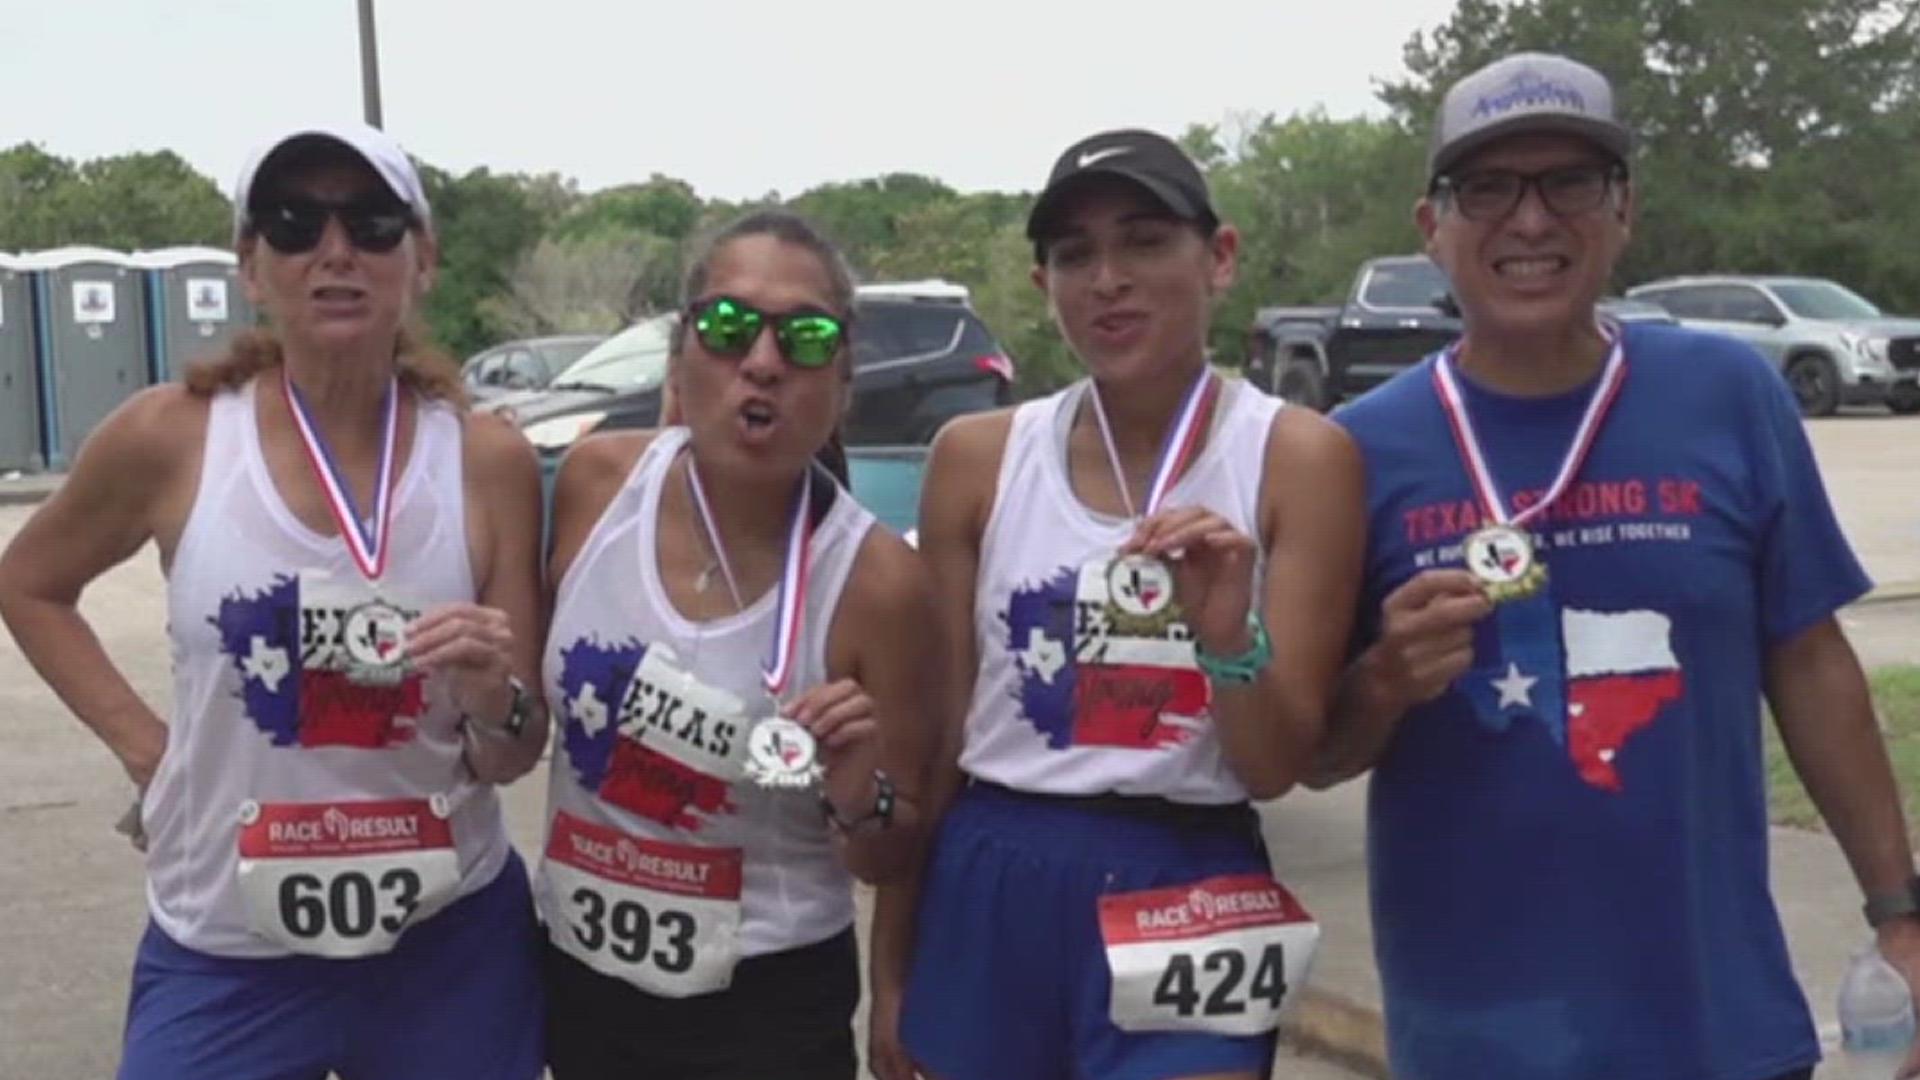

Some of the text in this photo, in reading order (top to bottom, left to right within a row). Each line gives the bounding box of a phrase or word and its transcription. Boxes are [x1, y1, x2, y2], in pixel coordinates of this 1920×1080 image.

[1404, 499, 1487, 544] TEXA
[1658, 479, 1700, 514] 5K
[1414, 549, 1435, 567] WE
[1554, 529, 1576, 547] WE
[1580, 526, 1613, 544] RISE
[1618, 523, 1691, 541] TOGETHER
[268, 815, 418, 842] RACE RESULT
[639, 854, 711, 882] RESULT
[278, 867, 421, 938] 603
[1135, 906, 1190, 931] RACE
[1216, 890, 1282, 914] RESULT
[571, 887, 697, 975] 393
[1153, 943, 1287, 1016] 424
